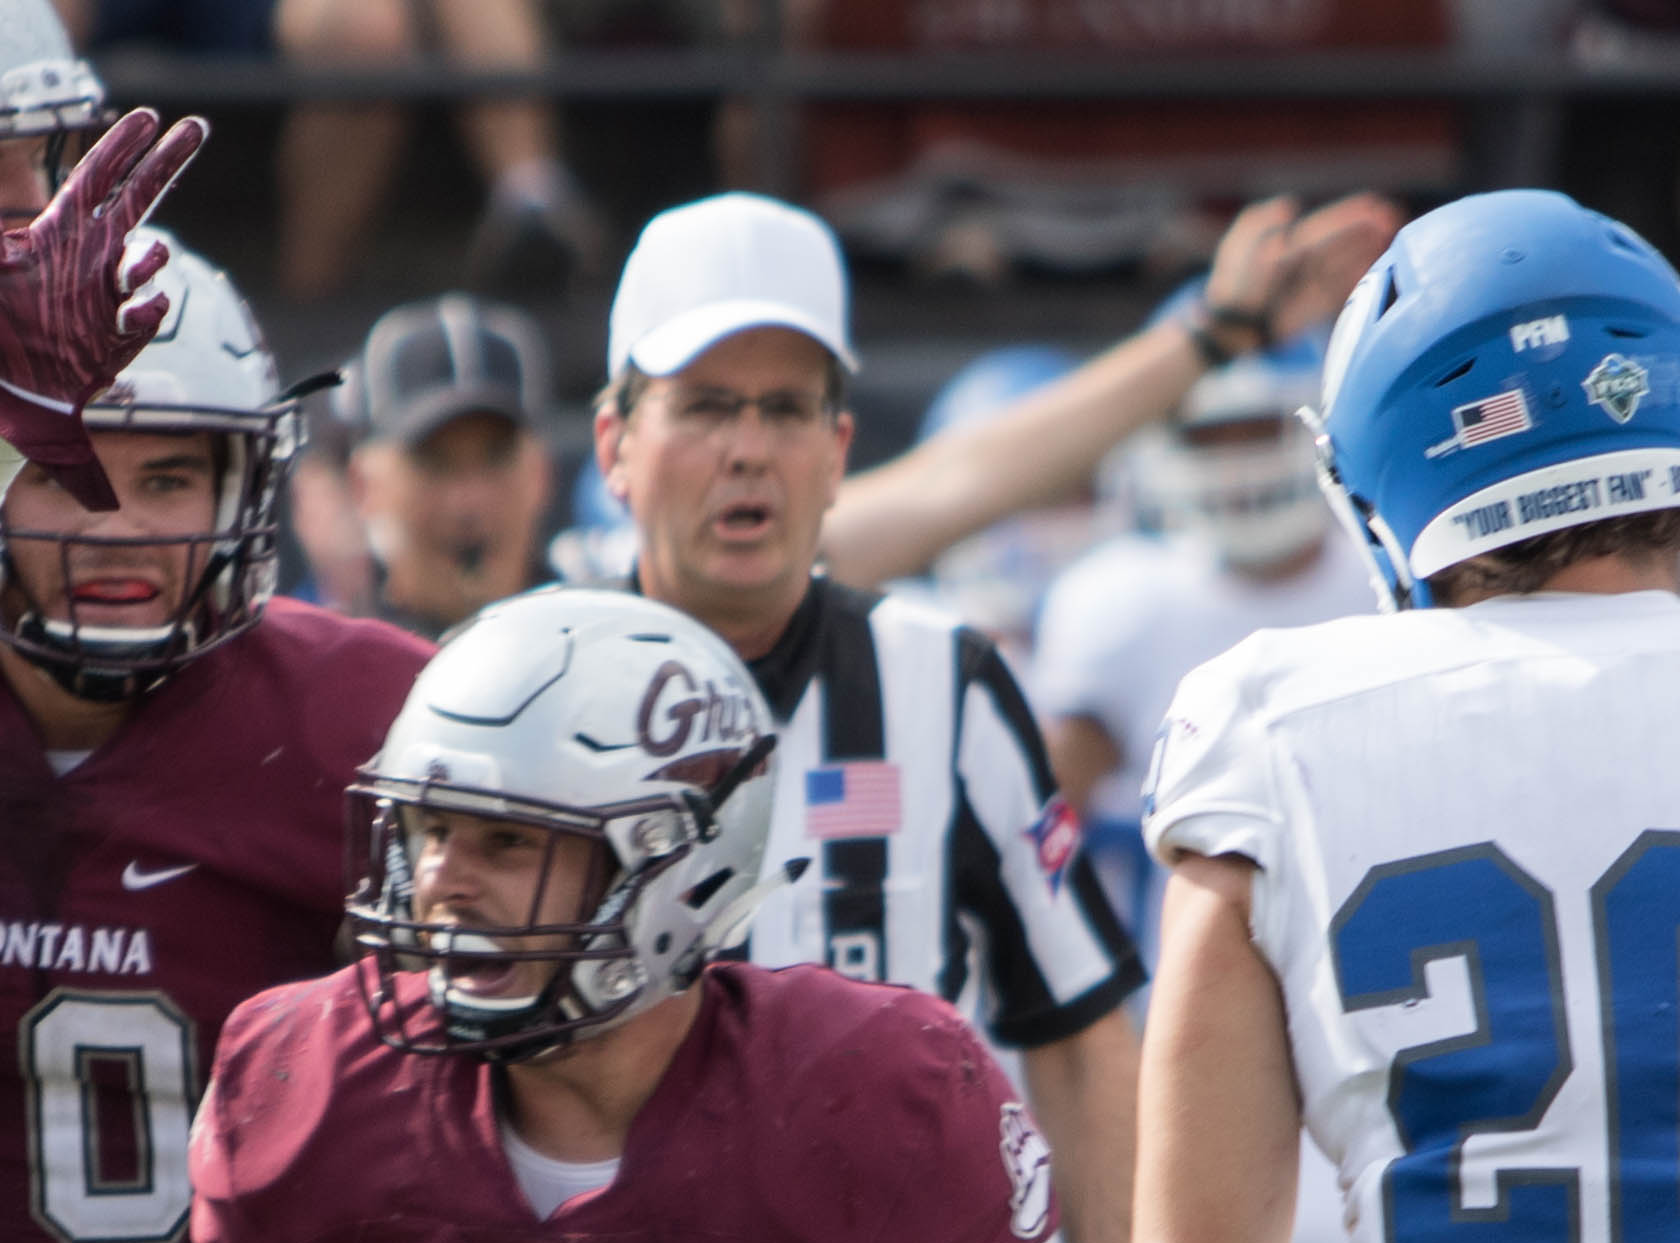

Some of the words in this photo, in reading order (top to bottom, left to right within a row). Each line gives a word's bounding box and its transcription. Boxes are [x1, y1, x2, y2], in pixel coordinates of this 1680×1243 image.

[1510, 314, 1569, 353] PFM
[1452, 500, 1514, 542] "YOUR
[1517, 477, 1602, 525] BIGGEST
[1607, 469, 1653, 505] FAN"
